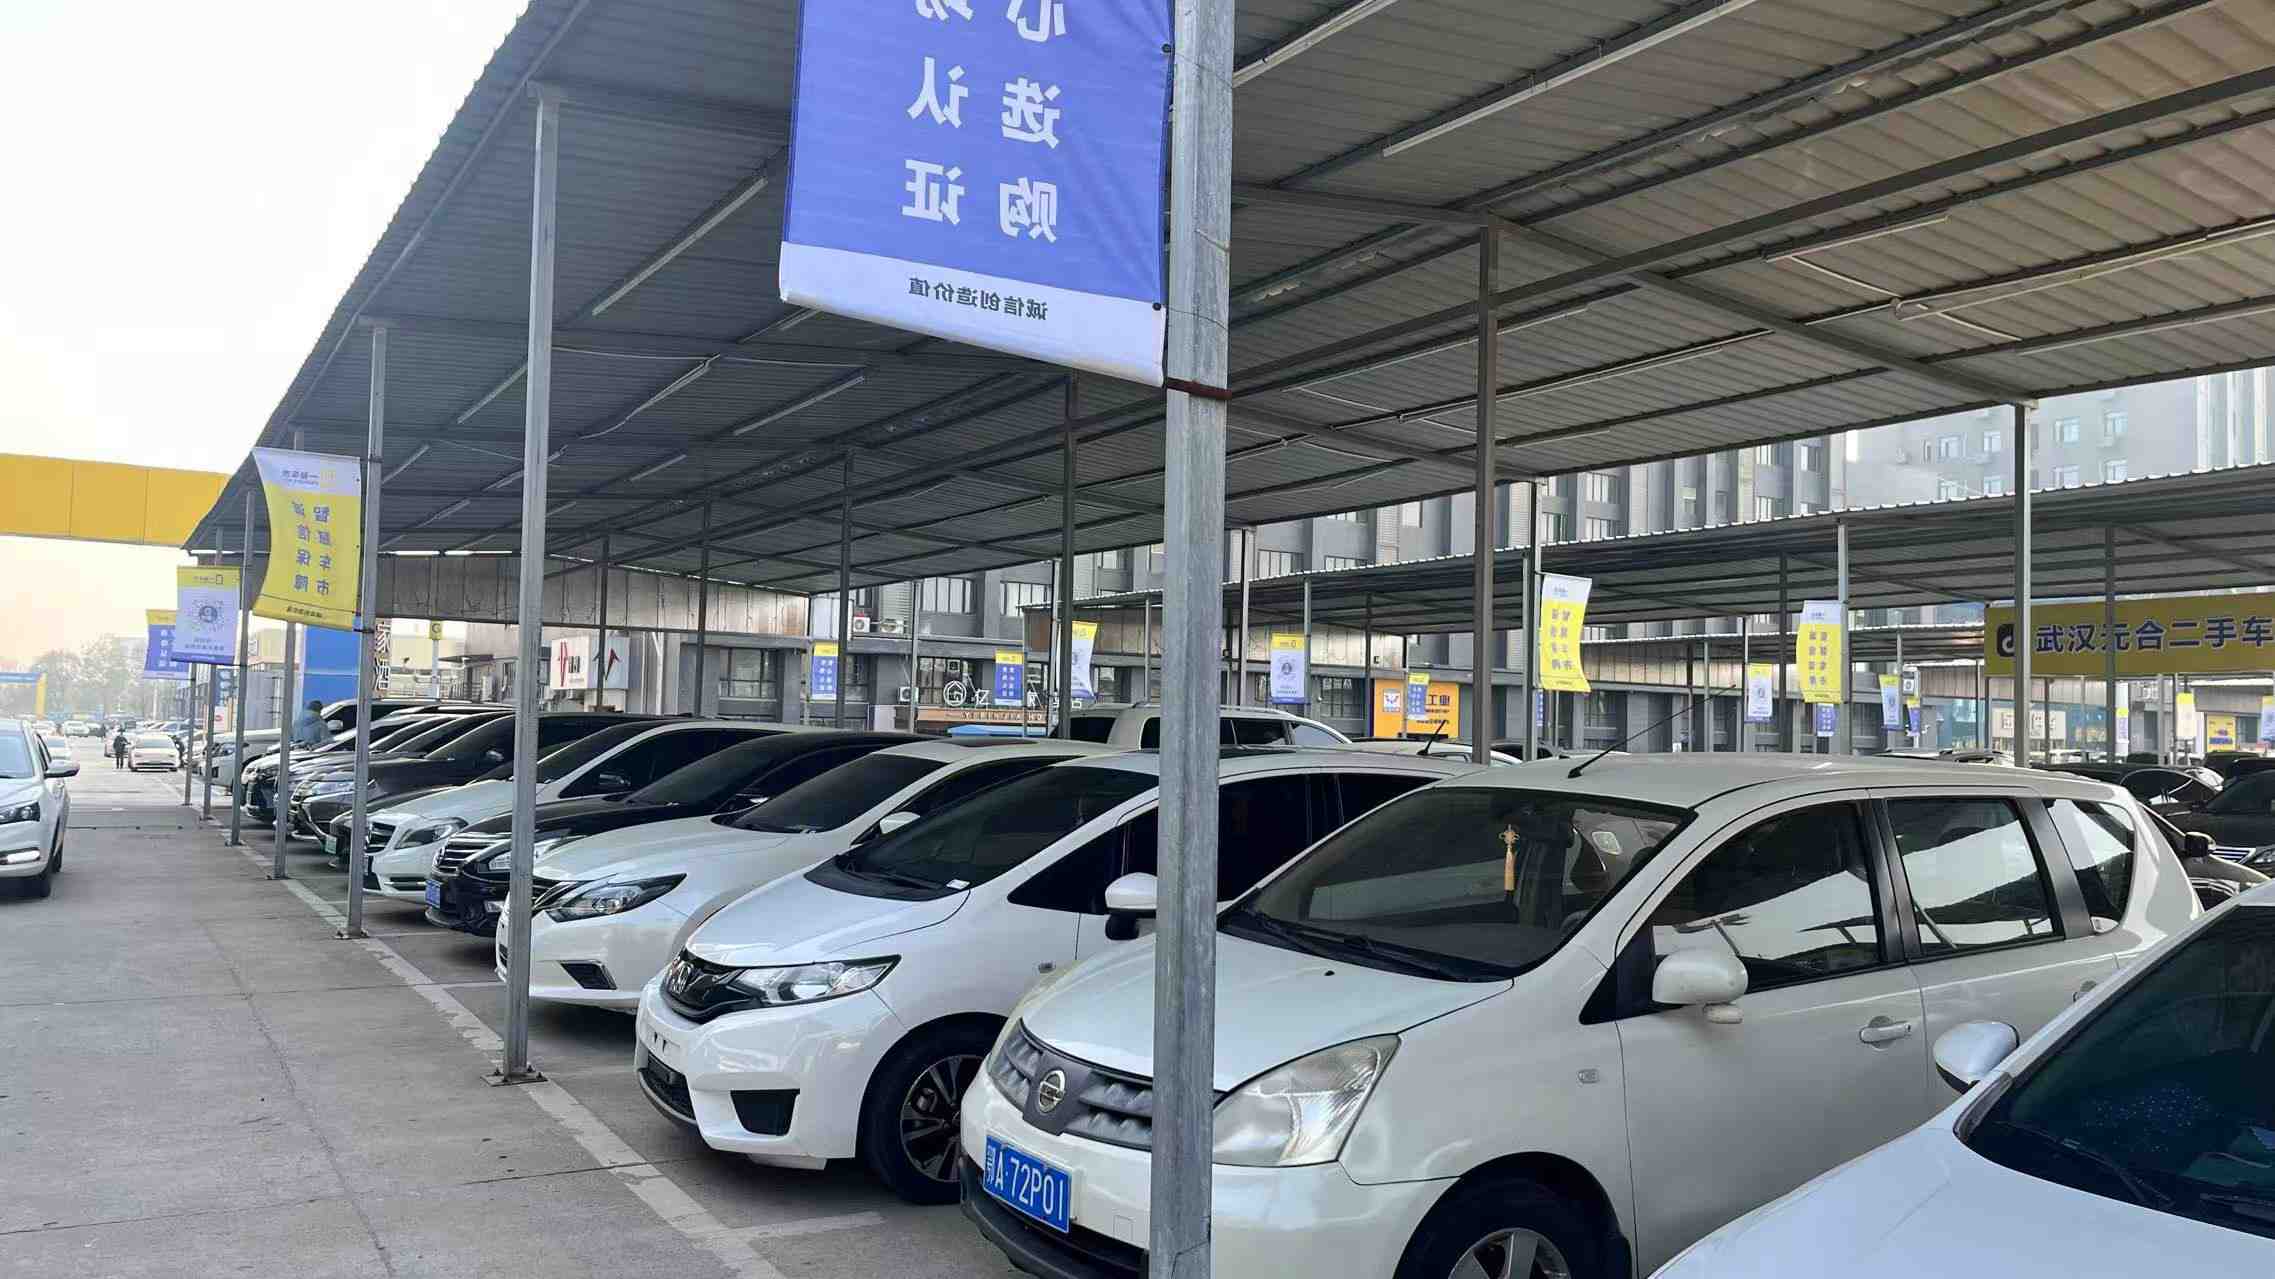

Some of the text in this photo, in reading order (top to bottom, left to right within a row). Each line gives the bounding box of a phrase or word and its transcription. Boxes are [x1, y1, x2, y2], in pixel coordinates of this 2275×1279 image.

[2035, 614, 2275, 653] 武汉元合二手车
